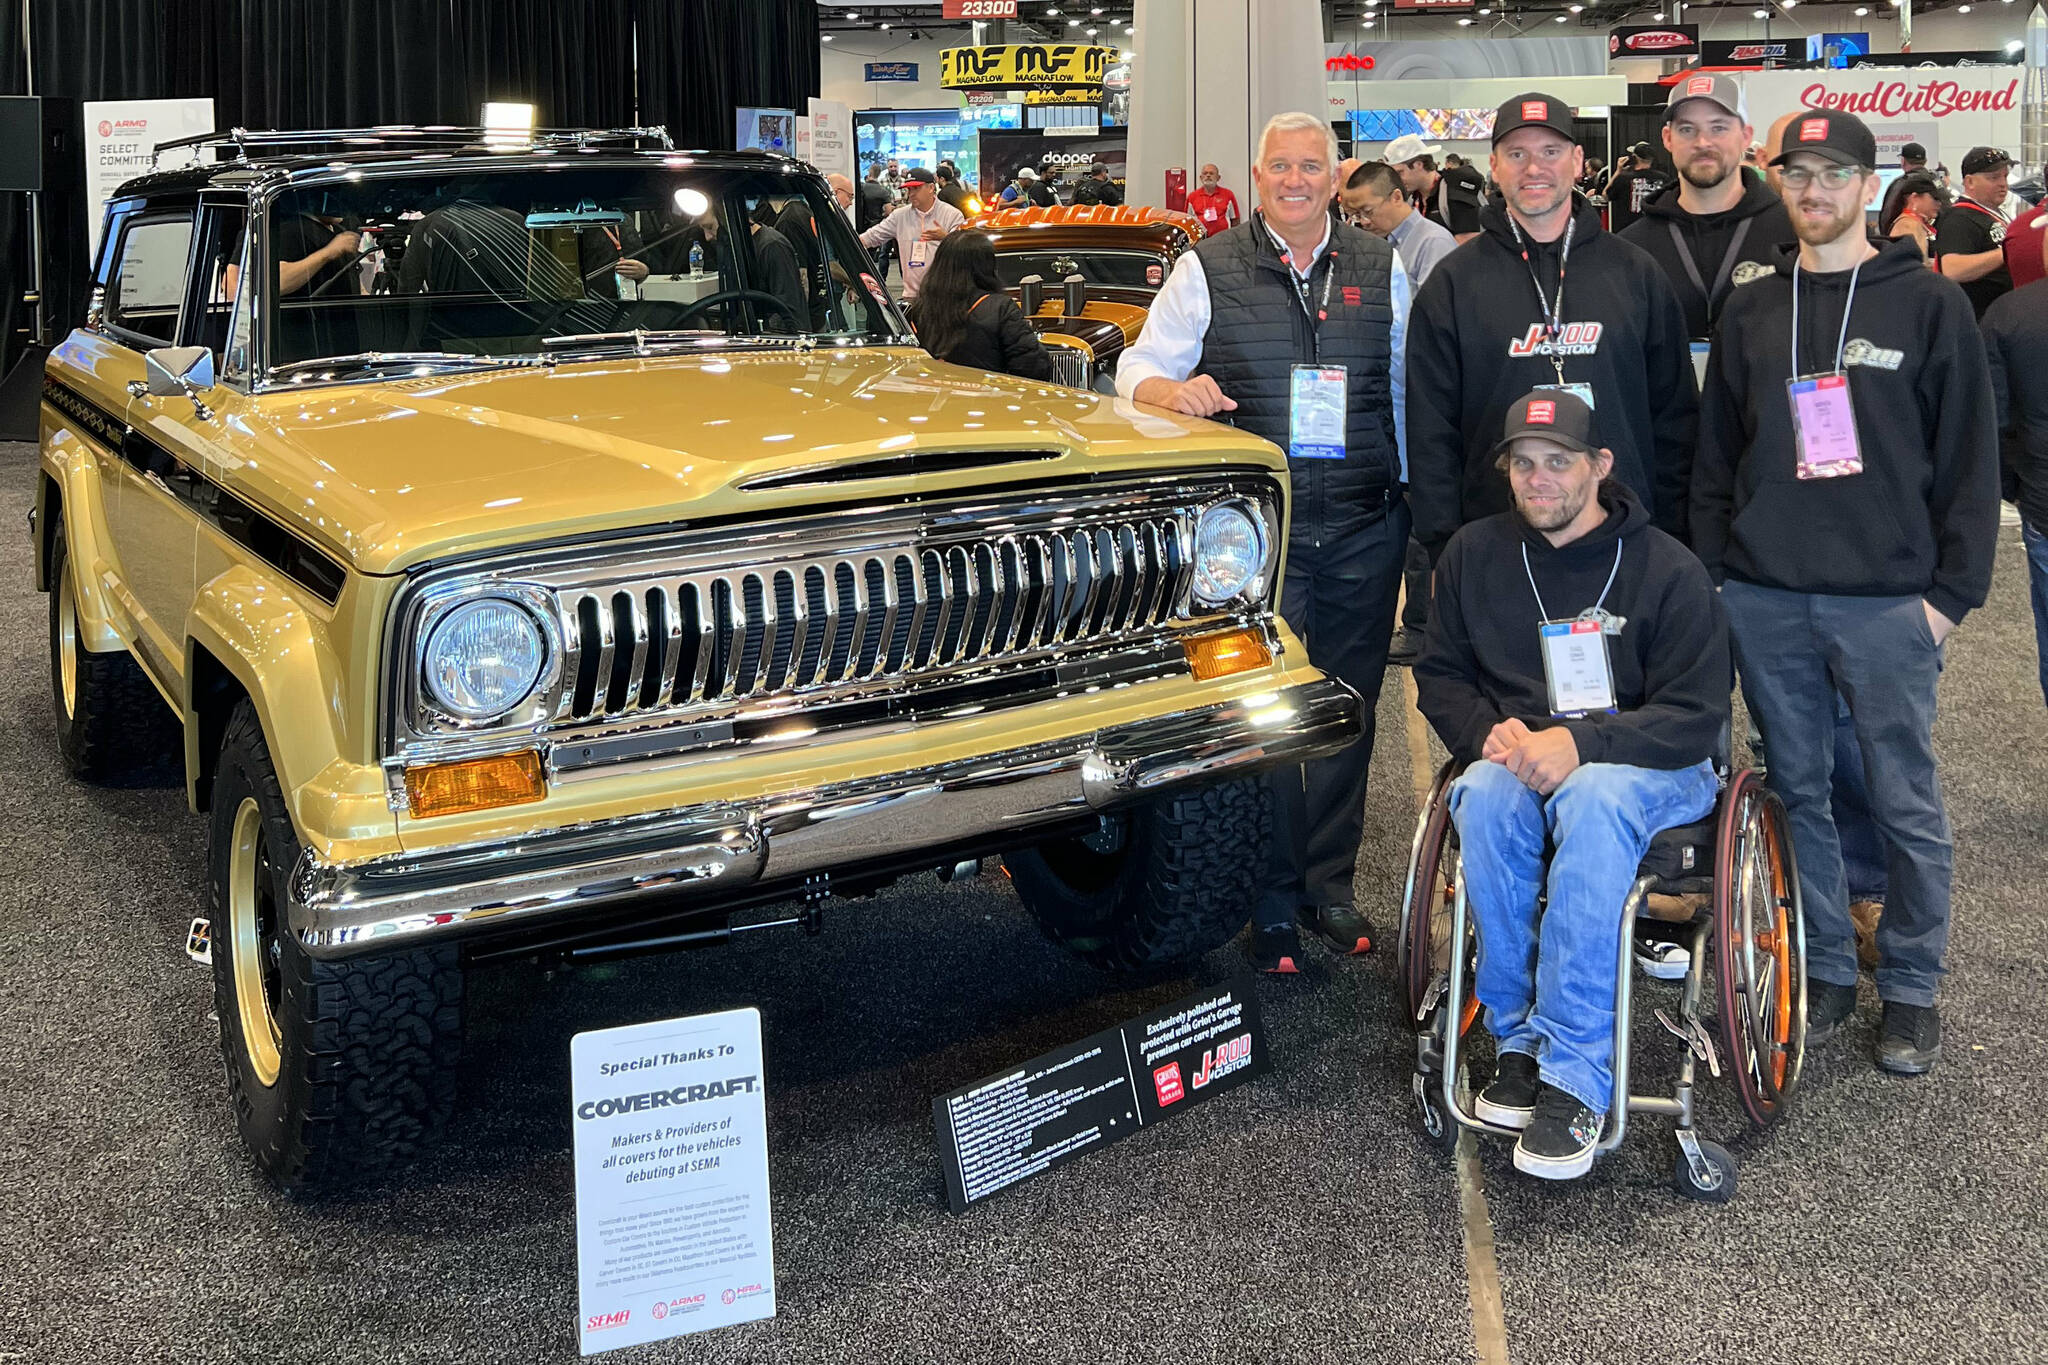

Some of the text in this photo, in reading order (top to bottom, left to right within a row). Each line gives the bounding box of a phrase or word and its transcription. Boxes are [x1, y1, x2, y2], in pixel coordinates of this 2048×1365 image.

[961, 1, 1015, 16] 23300
[1325, 53, 1375, 70] mbo
[1729, 45, 1786, 60] AMSOIL
[957, 75, 1003, 83] MAGNAFLOW
[1016, 74, 1074, 82] MAGNAFLOW
[1800, 79, 2019, 117] SendCutSend
[100, 144, 139, 153] SELECT
[1042, 151, 1096, 166] dapper
[100, 155, 154, 166] COMMITTE
[1540, 344, 1597, 355] CSTOM
[1147, 991, 1232, 1036] Exclusively polished and
[1140, 1003, 1243, 1055] protected with Griot's Garage
[1146, 1016, 1242, 1066] premium car care products
[600, 1044, 735, 1076] Special Thanks To
[1215, 1055, 1252, 1080] CUSTOM
[577, 1075, 758, 1120] COVERCRAFT
[612, 1116, 732, 1149] Makers & Providers of
[602, 1134, 742, 1169] all covers for the vehicles
[626, 1156, 721, 1184] debuting at SEMA
[670, 1293, 706, 1307] ARMO
